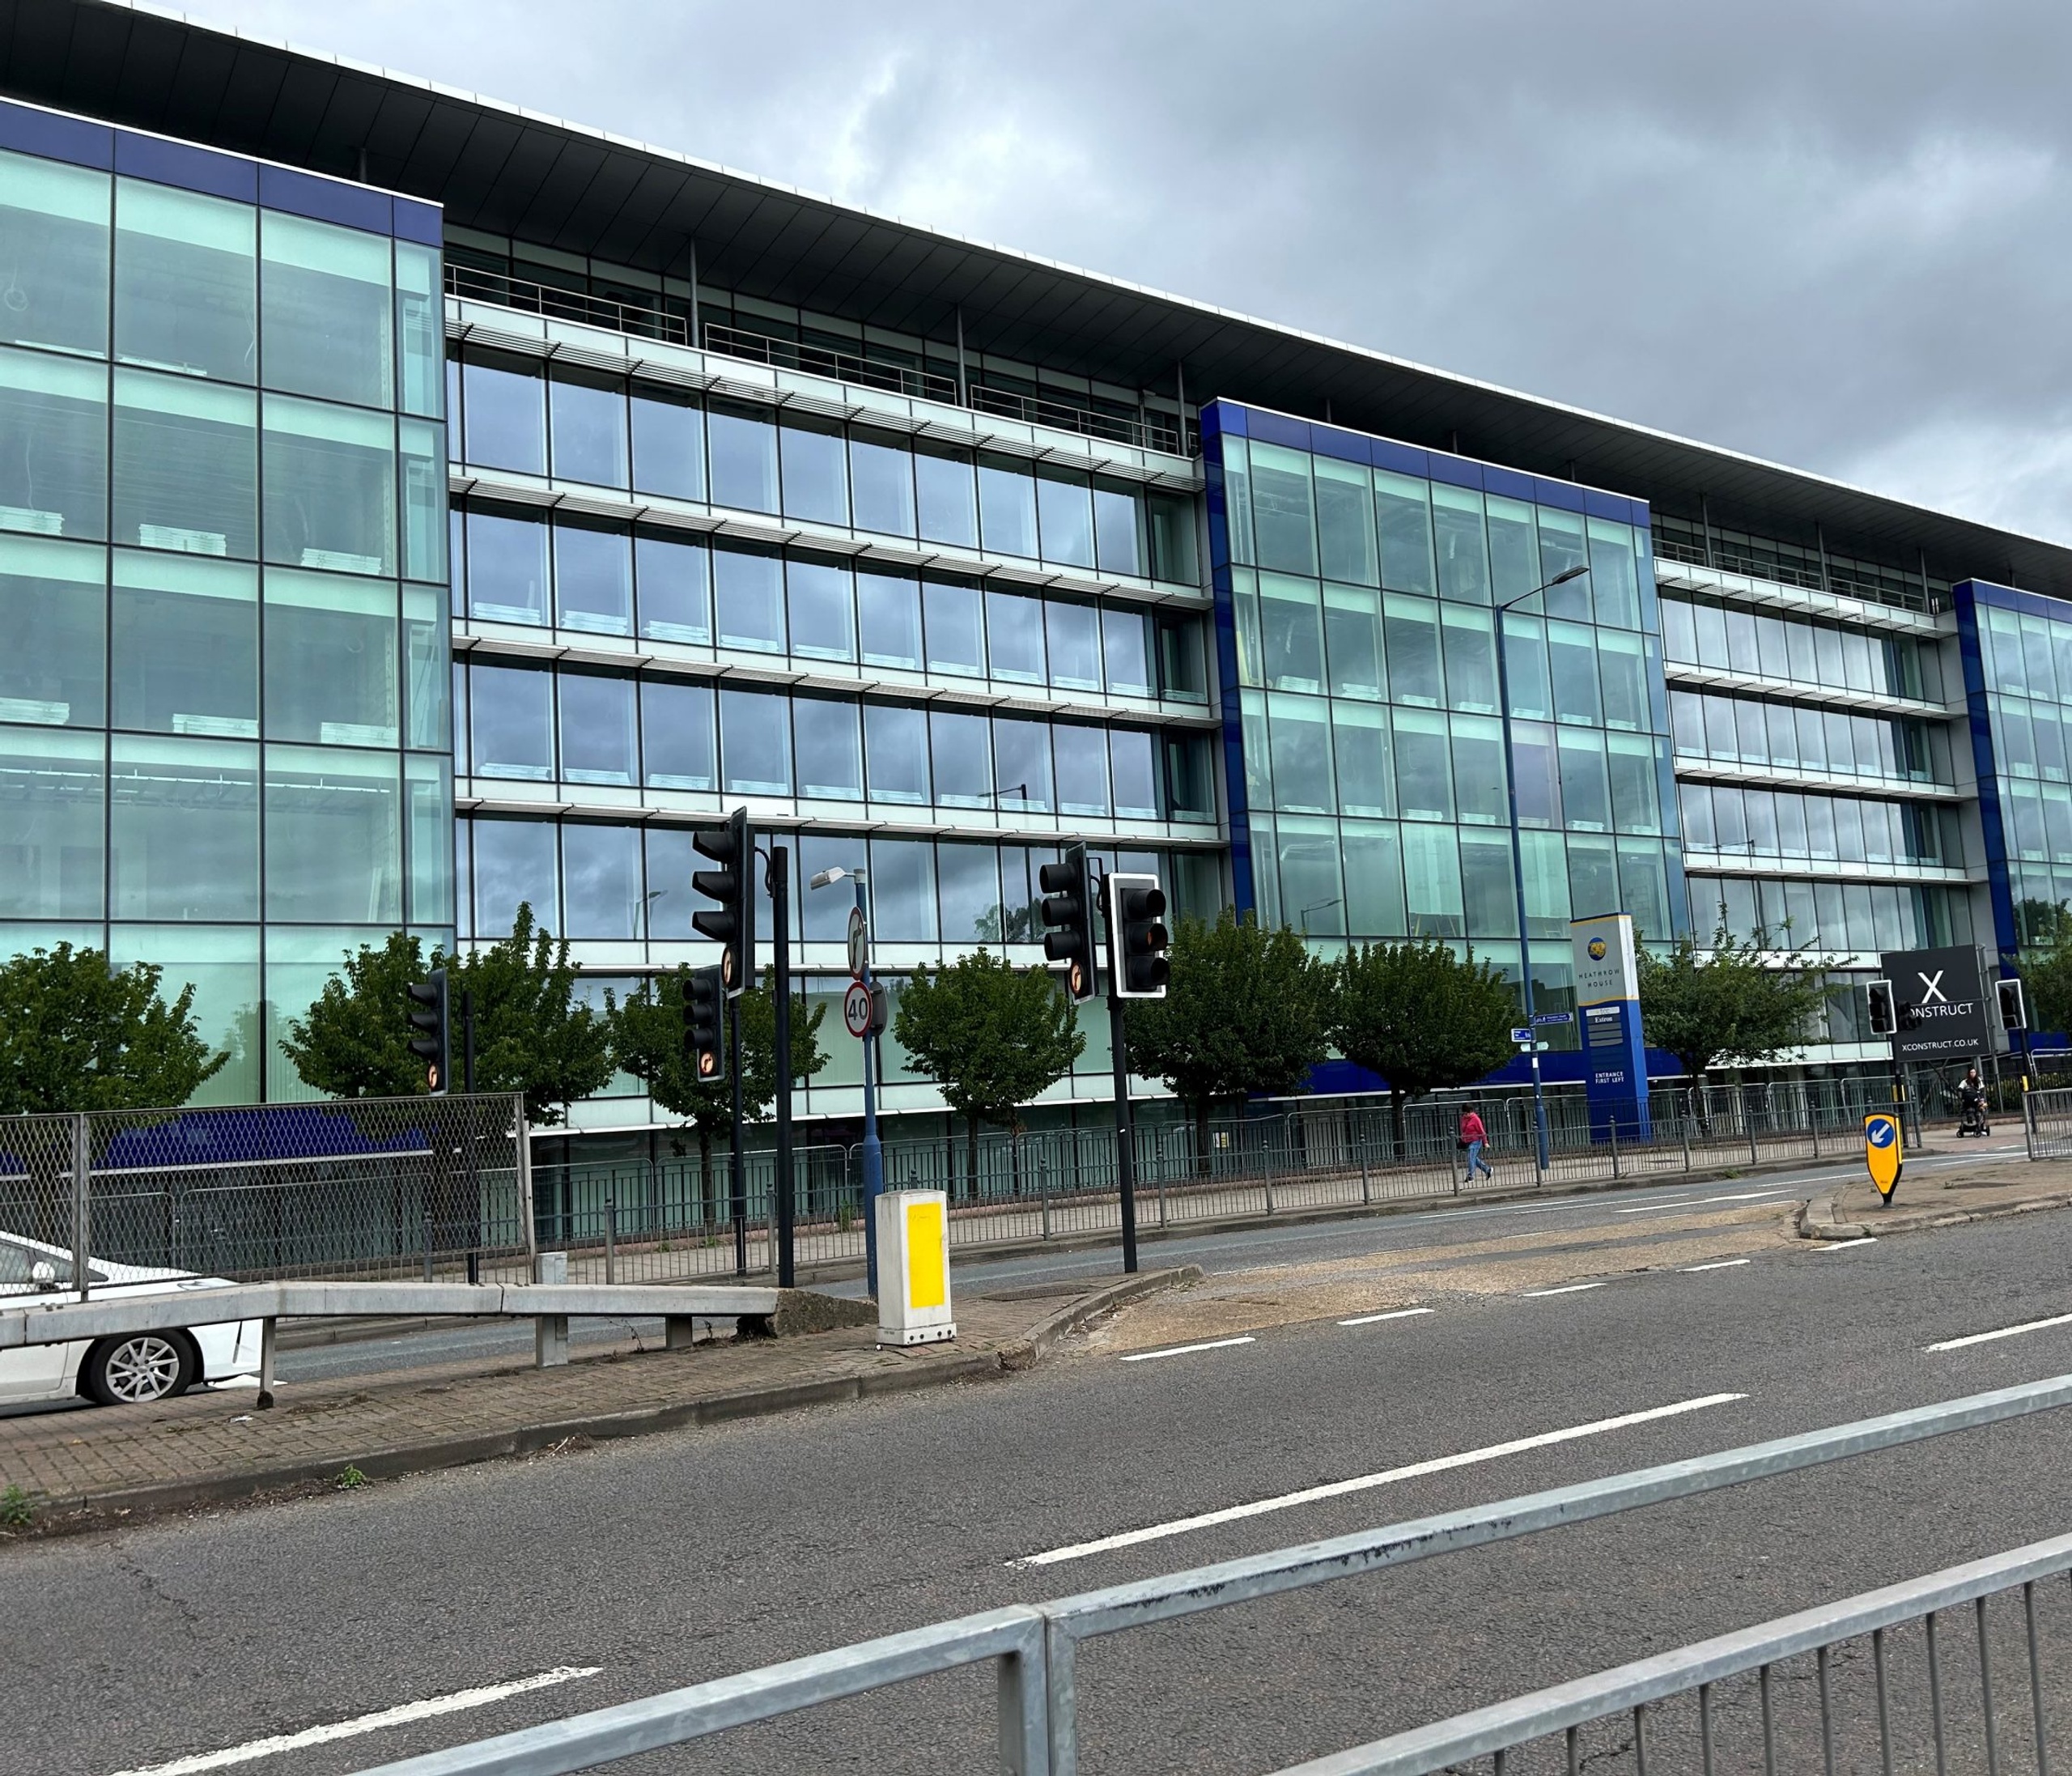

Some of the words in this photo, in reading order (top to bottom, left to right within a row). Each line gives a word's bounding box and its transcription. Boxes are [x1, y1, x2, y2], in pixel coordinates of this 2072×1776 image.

[1578, 969, 1620, 979] HEATHROW
[1587, 979, 1613, 988] HOUSE
[1917, 970, 1947, 1004] X
[847, 998, 868, 1021] 40
[1910, 1002, 1973, 1018] NSTRUCT
[1901, 1039, 1979, 1052] XCONSTRUCT.CO.UK
